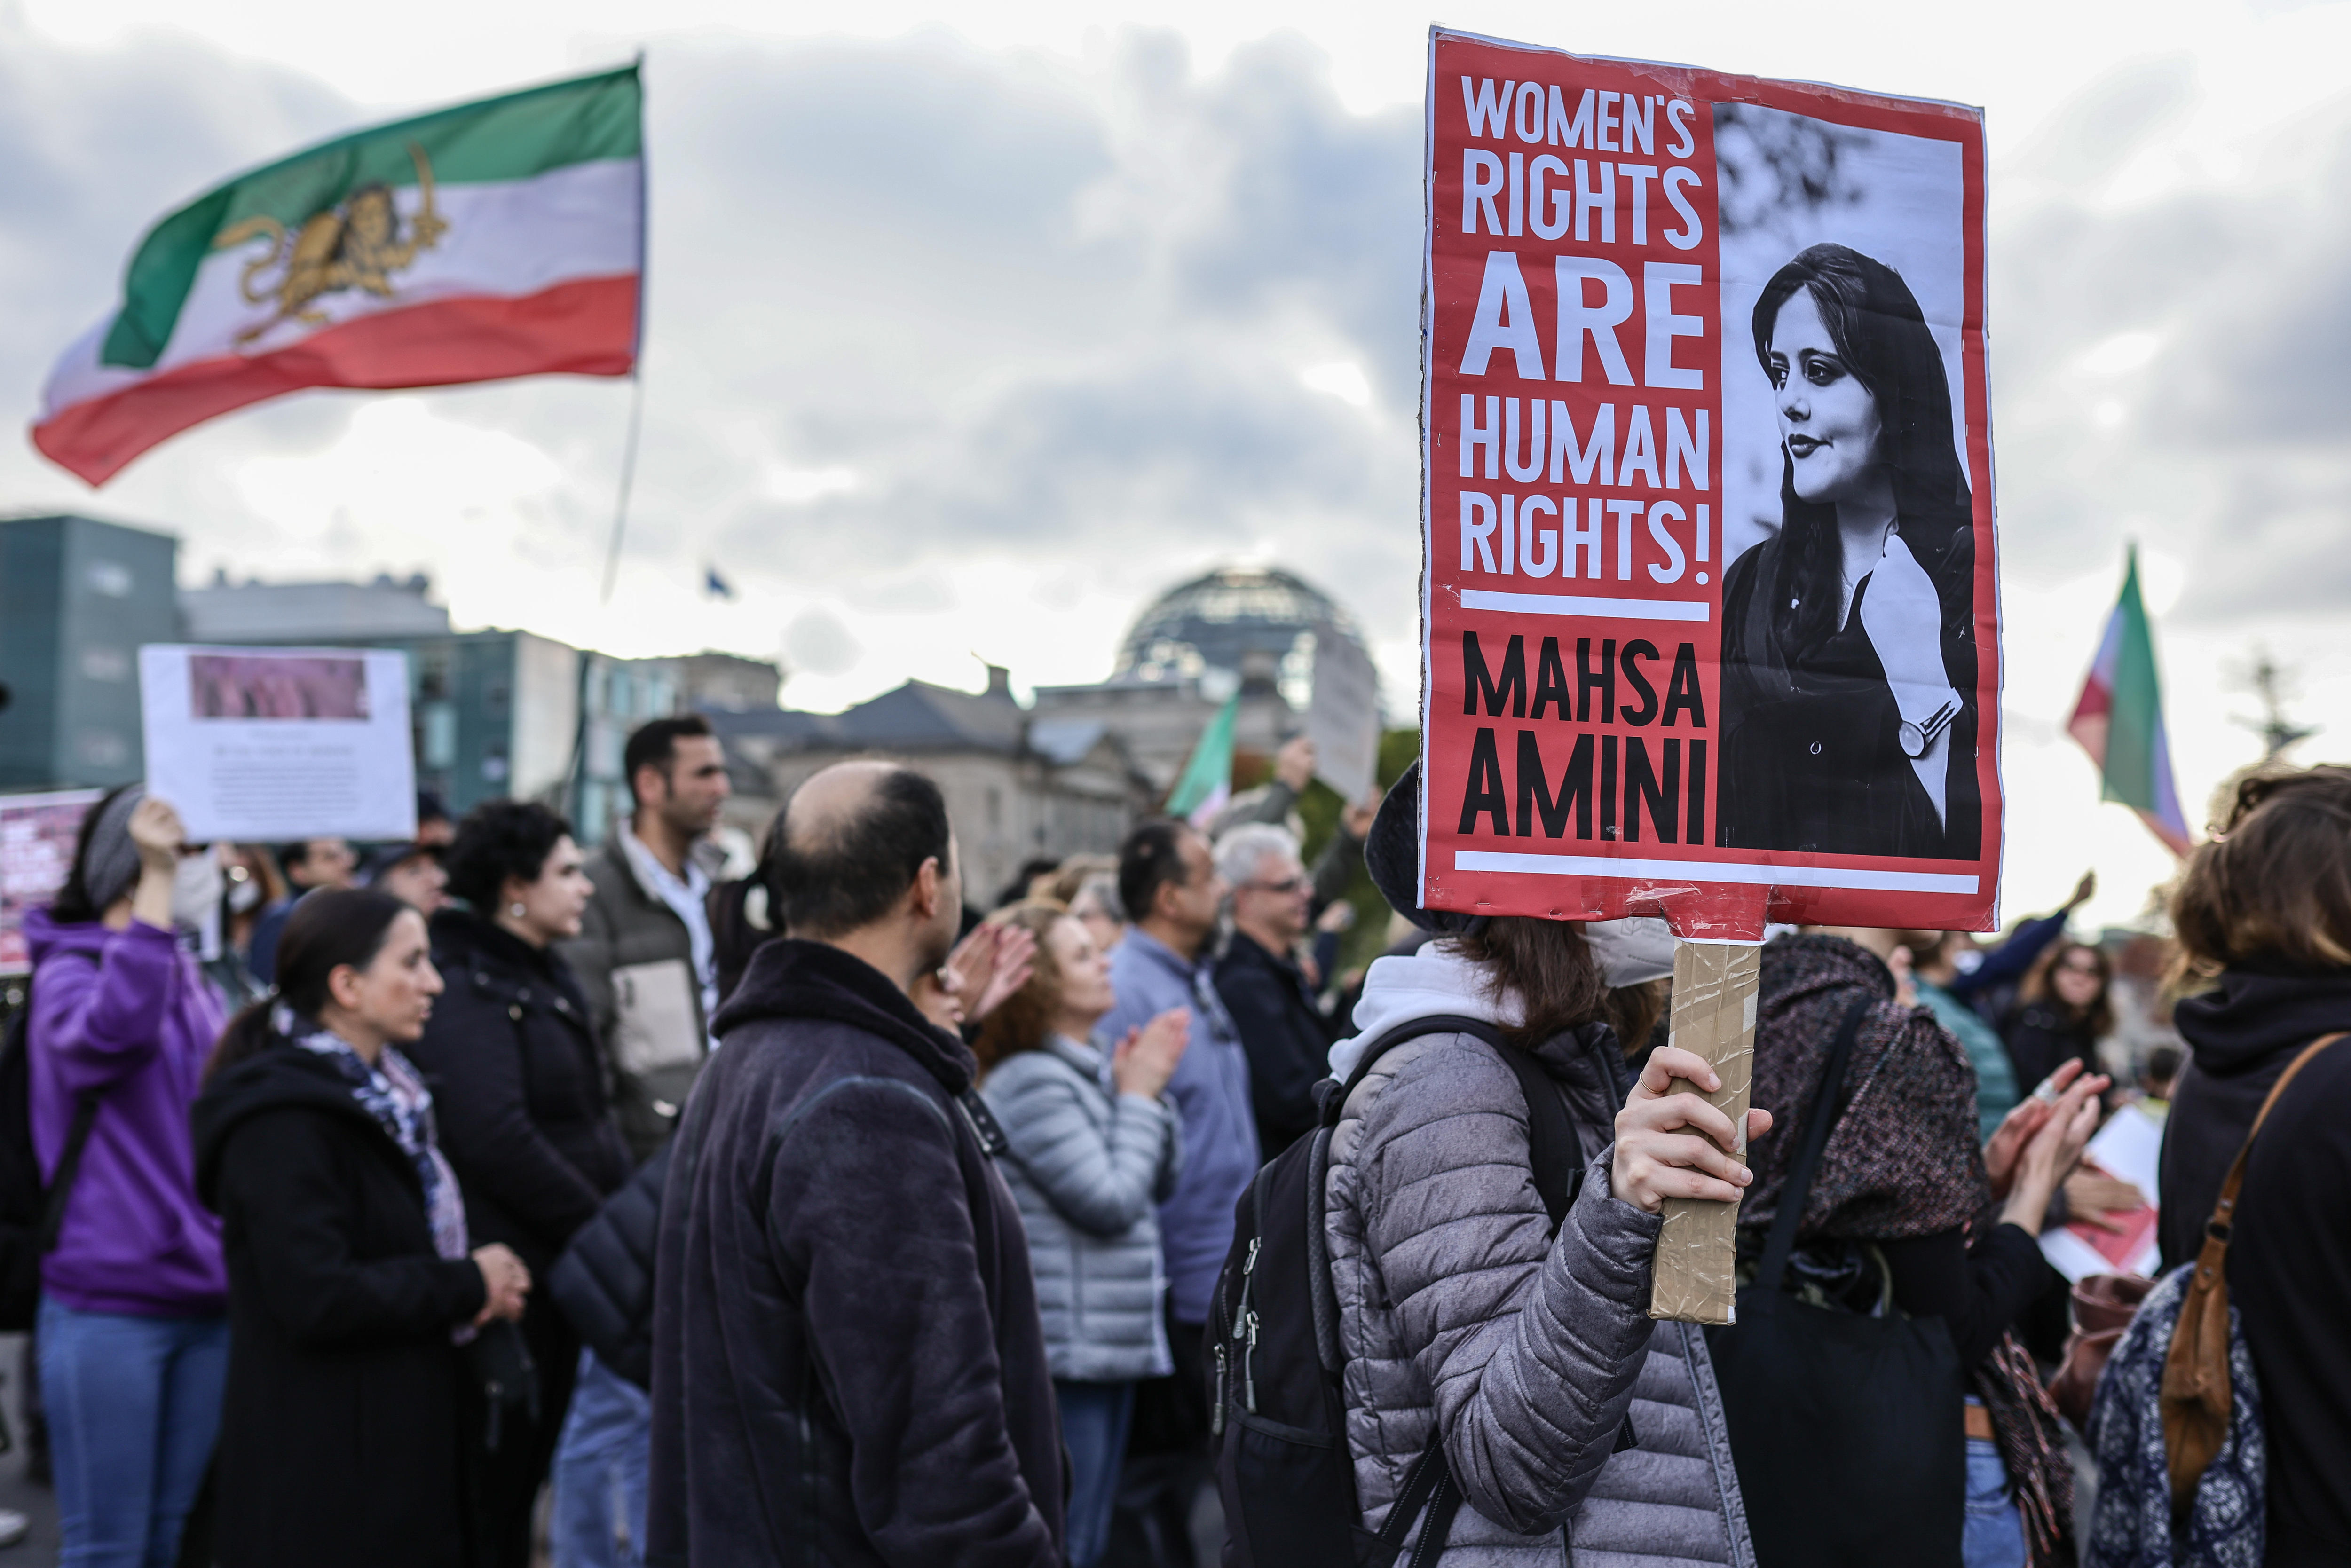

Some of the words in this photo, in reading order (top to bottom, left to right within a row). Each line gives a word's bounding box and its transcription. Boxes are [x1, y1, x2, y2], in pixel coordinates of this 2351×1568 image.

[1461, 75, 1695, 158] WOMEN'S
[1462, 148, 1703, 250] RIGHTS
[1459, 250, 1703, 390] ARE
[1460, 394, 1709, 491] HUMAN
[1460, 490, 1710, 585] RIGHTS!
[1462, 630, 1707, 728] MAHSA
[1457, 727, 1707, 845] AMINI
